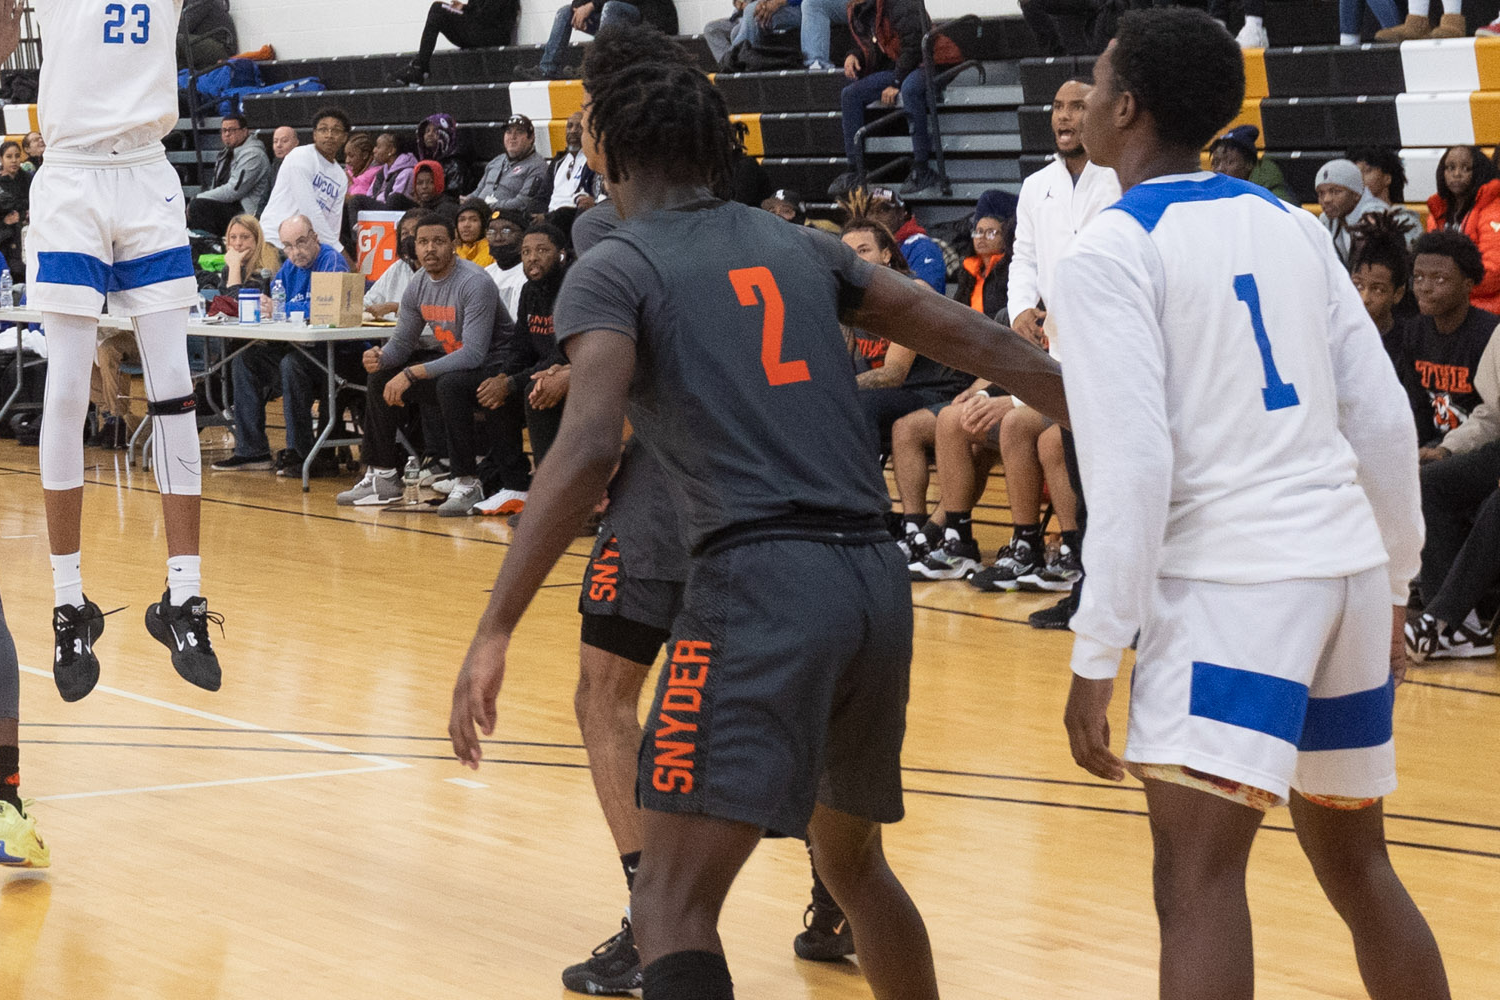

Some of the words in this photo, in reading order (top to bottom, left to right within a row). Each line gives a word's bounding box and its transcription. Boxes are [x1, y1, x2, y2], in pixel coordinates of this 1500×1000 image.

[103, 3, 151, 44] 23
[728, 266, 812, 387] 2
[1233, 272, 1300, 411] 1
[589, 536, 621, 602] SNY
[652, 639, 712, 794] SNYDER
